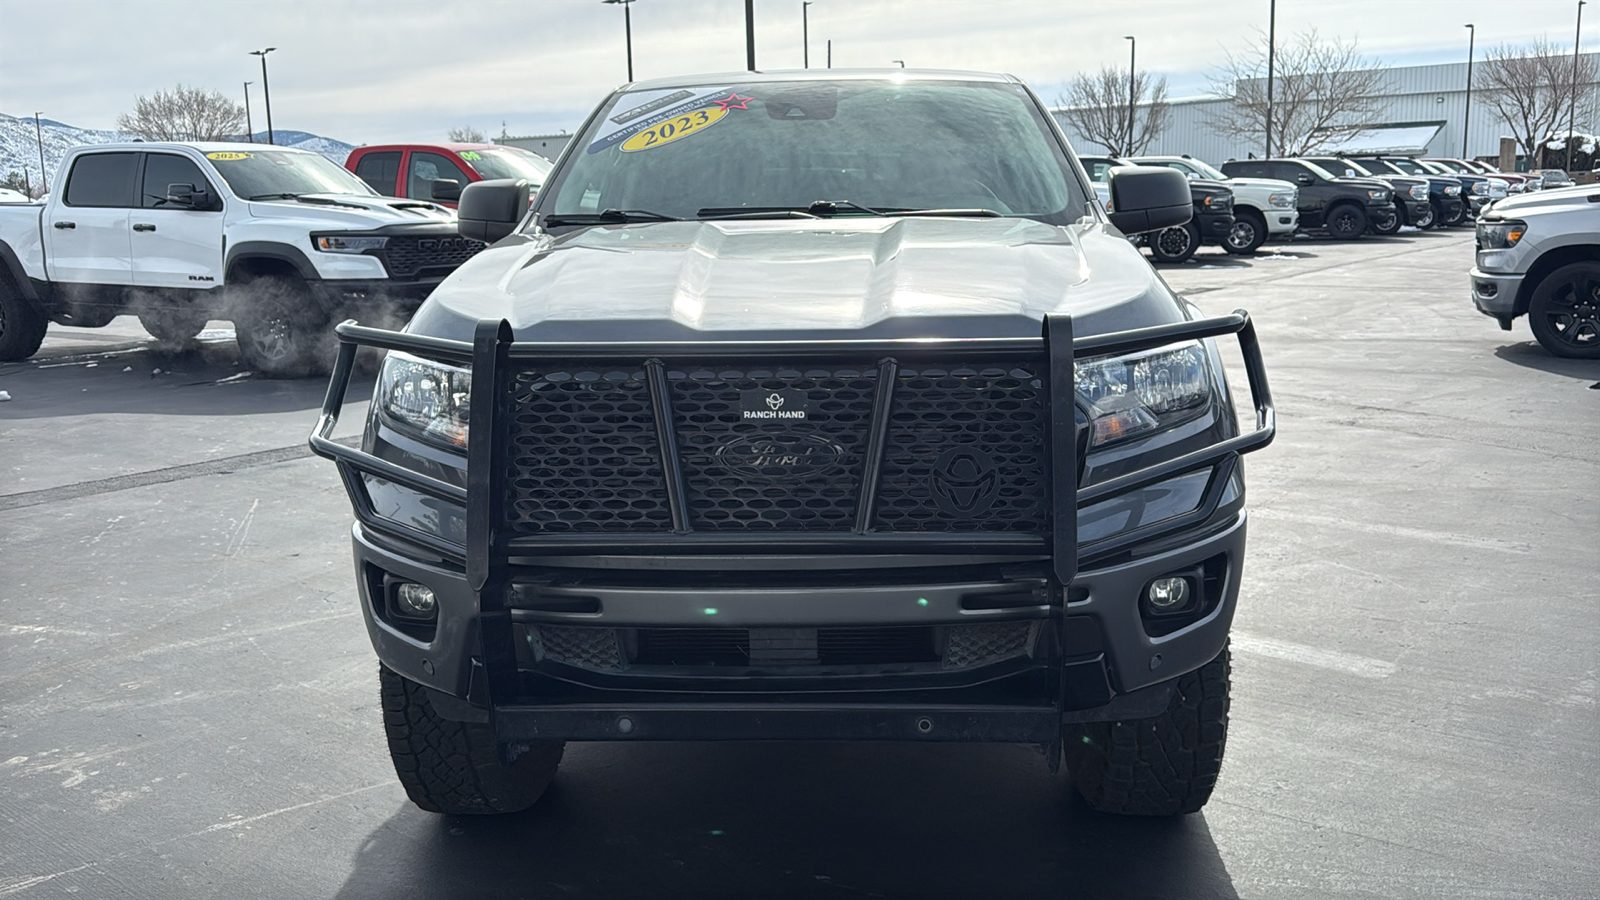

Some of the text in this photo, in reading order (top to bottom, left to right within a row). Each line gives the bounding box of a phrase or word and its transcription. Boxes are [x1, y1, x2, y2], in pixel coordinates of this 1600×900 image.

[607, 120, 648, 141] CERTIFIED
[648, 102, 694, 124] PRE-OWNED
[694, 91, 728, 105] VEHICLE
[642, 110, 709, 147] 2023
[418, 238, 470, 251] RAM
[743, 410, 805, 419] RANCH HAND
